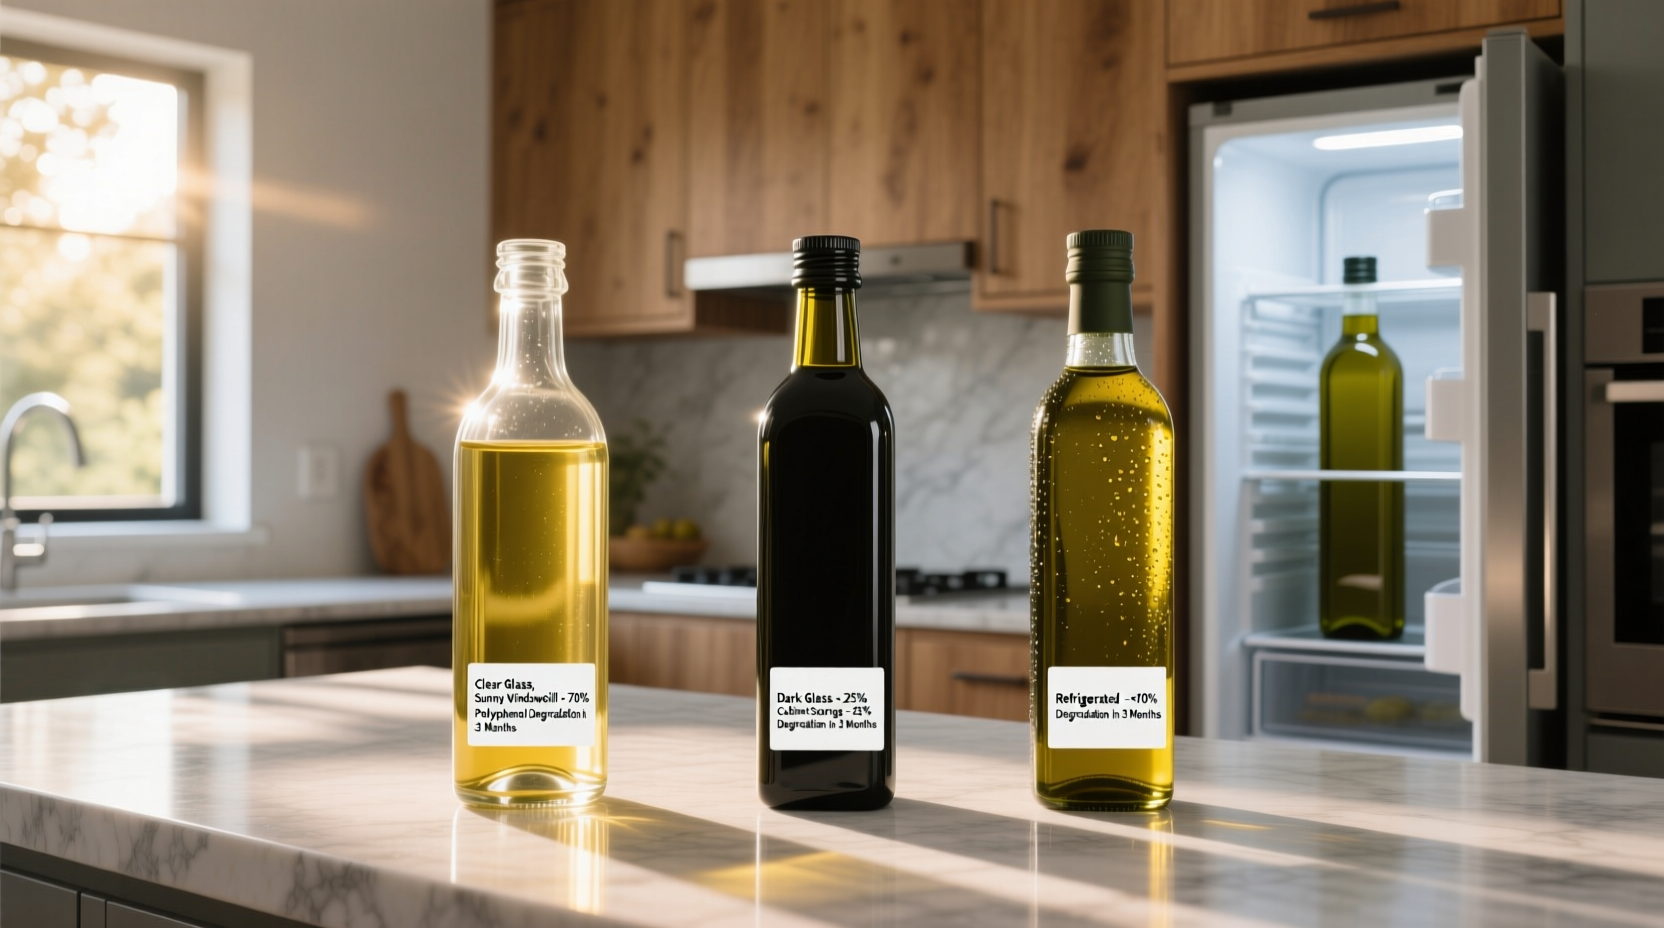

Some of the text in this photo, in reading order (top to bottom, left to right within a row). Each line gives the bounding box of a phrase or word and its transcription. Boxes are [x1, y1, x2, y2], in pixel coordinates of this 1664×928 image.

[474, 678, 502, 690] Clear
[474, 692, 504, 705] Sunny
[567, 692, 590, 703] 70%
[777, 692, 802, 703] Dark
[842, 692, 868, 703] 25%
[1122, 709, 1128, 719] 3
[474, 722, 481, 732] 3
